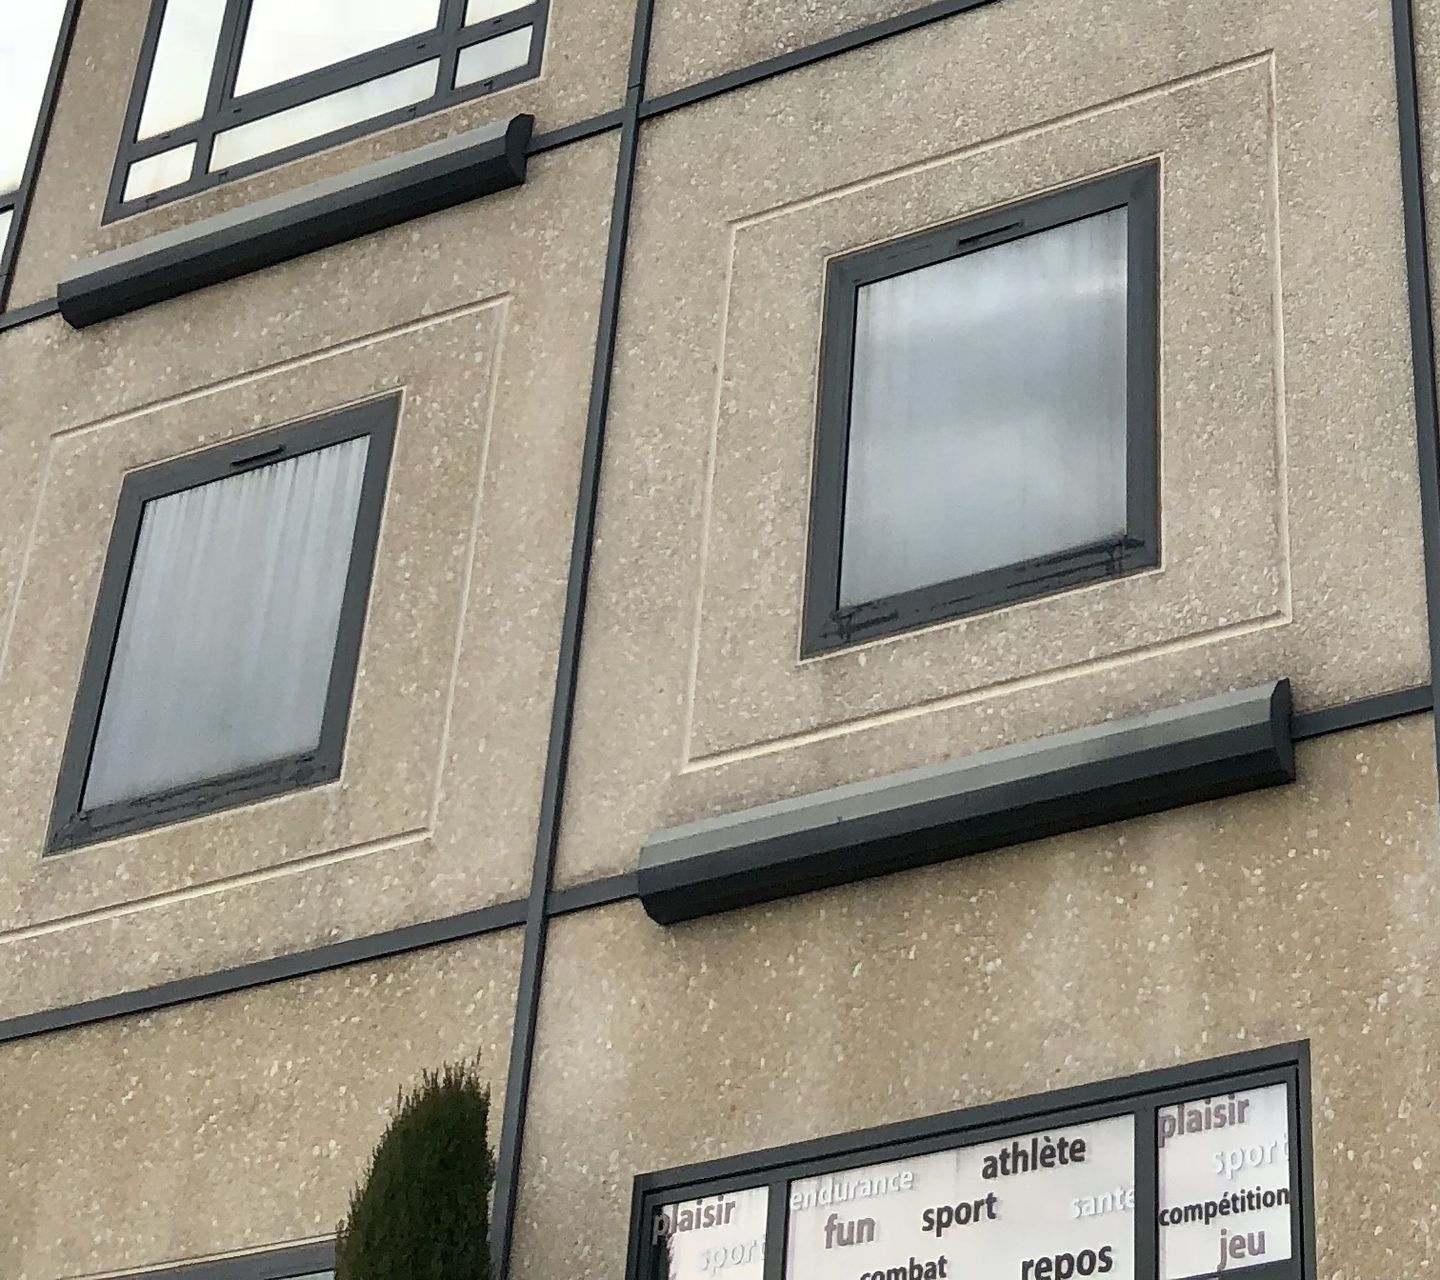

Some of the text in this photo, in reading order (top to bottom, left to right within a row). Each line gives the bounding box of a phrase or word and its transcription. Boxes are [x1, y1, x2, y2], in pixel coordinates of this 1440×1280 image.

[1158, 1093, 1250, 1149] plaisir
[981, 1135, 1087, 1180] athlète
[790, 1169, 915, 1212] endurance
[1158, 1186, 1290, 1227] compétition
[824, 1213, 876, 1250] fun
[922, 1192, 998, 1238] sport
[859, 1255, 948, 1280] combat
[1021, 1245, 1113, 1280] repos
[1216, 1228, 1266, 1272] jeu
